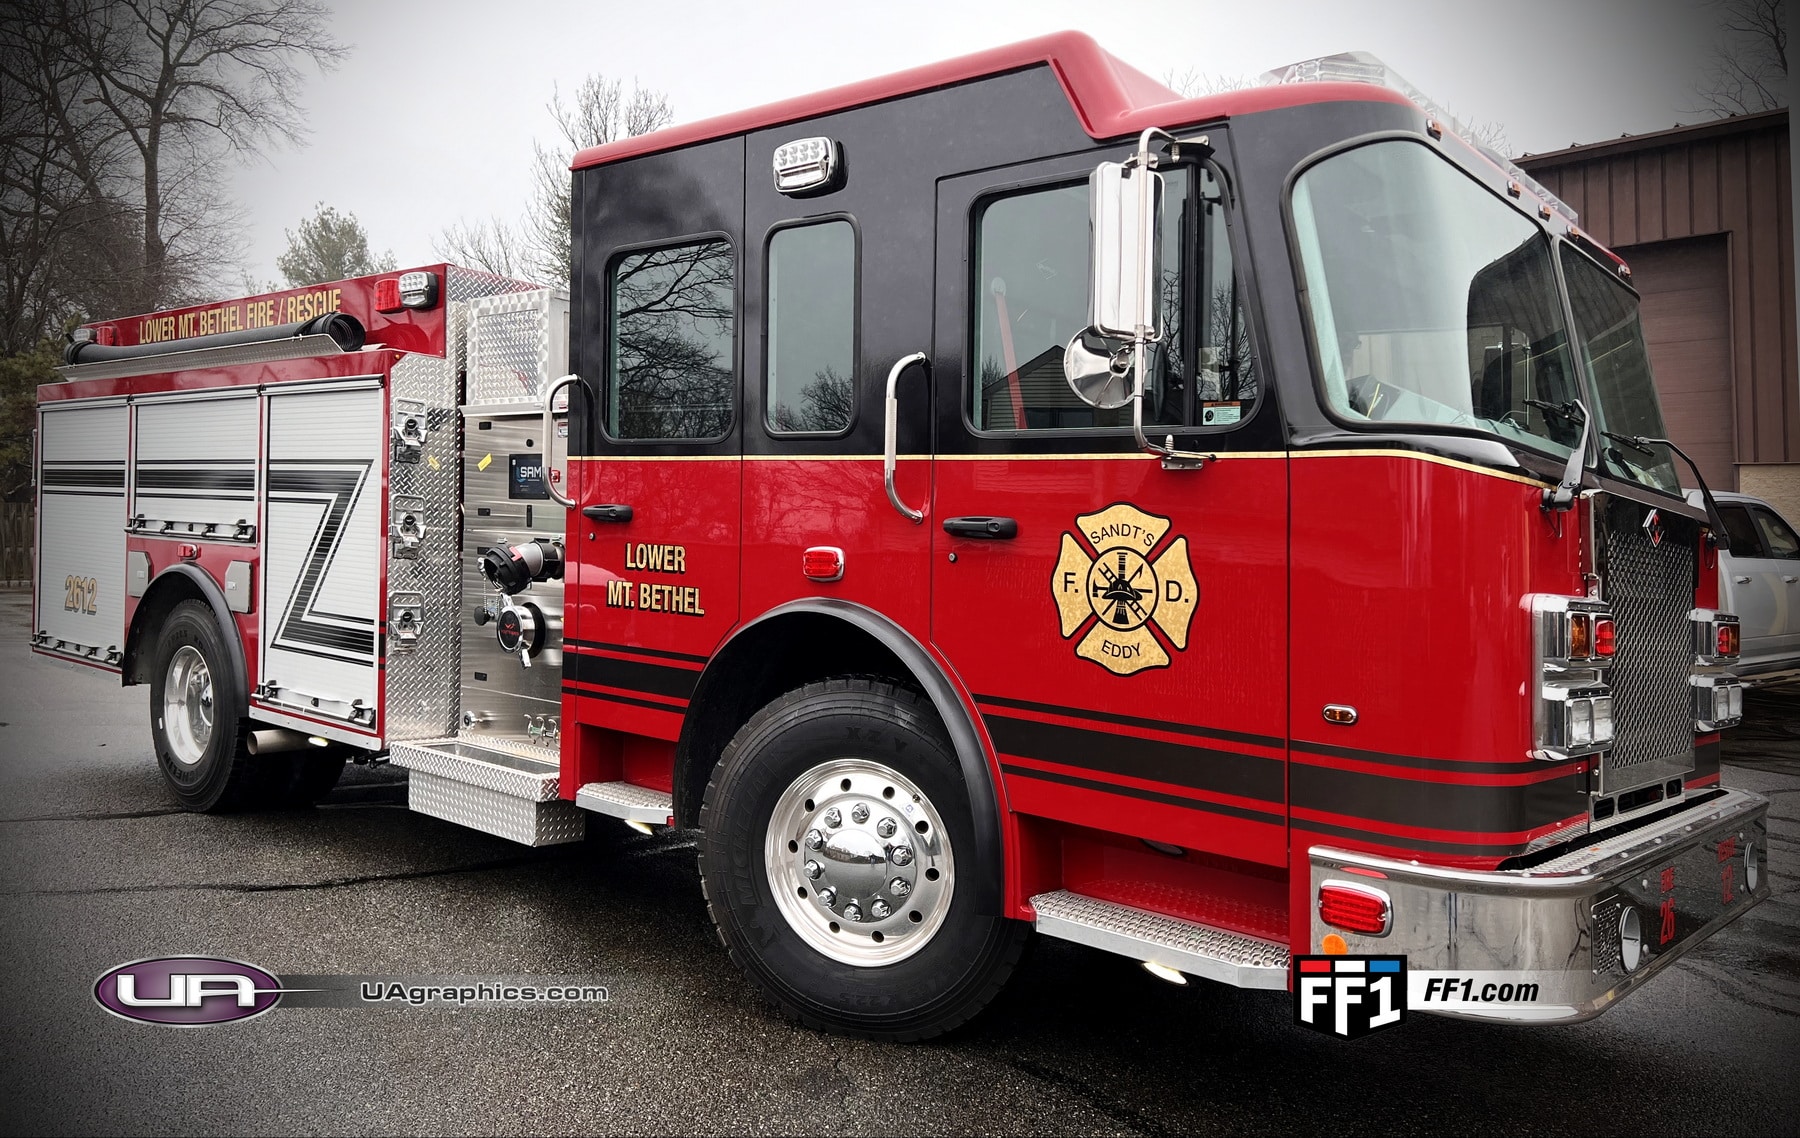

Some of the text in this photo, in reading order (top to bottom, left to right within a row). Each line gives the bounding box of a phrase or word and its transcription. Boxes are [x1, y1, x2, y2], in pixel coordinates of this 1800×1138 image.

[139, 289, 342, 344] LOWER MT. BETHEL FIRE / RESCUE
[1090, 523, 1155, 547] SANDT'S
[625, 542, 686, 574] LOWER
[64, 574, 98, 616] 2612
[606, 580, 706, 618] MT. BETHEL
[1063, 571, 1189, 604] F. D.
[1101, 639, 1141, 659] EDDY
[1660, 897, 1676, 945] 26
